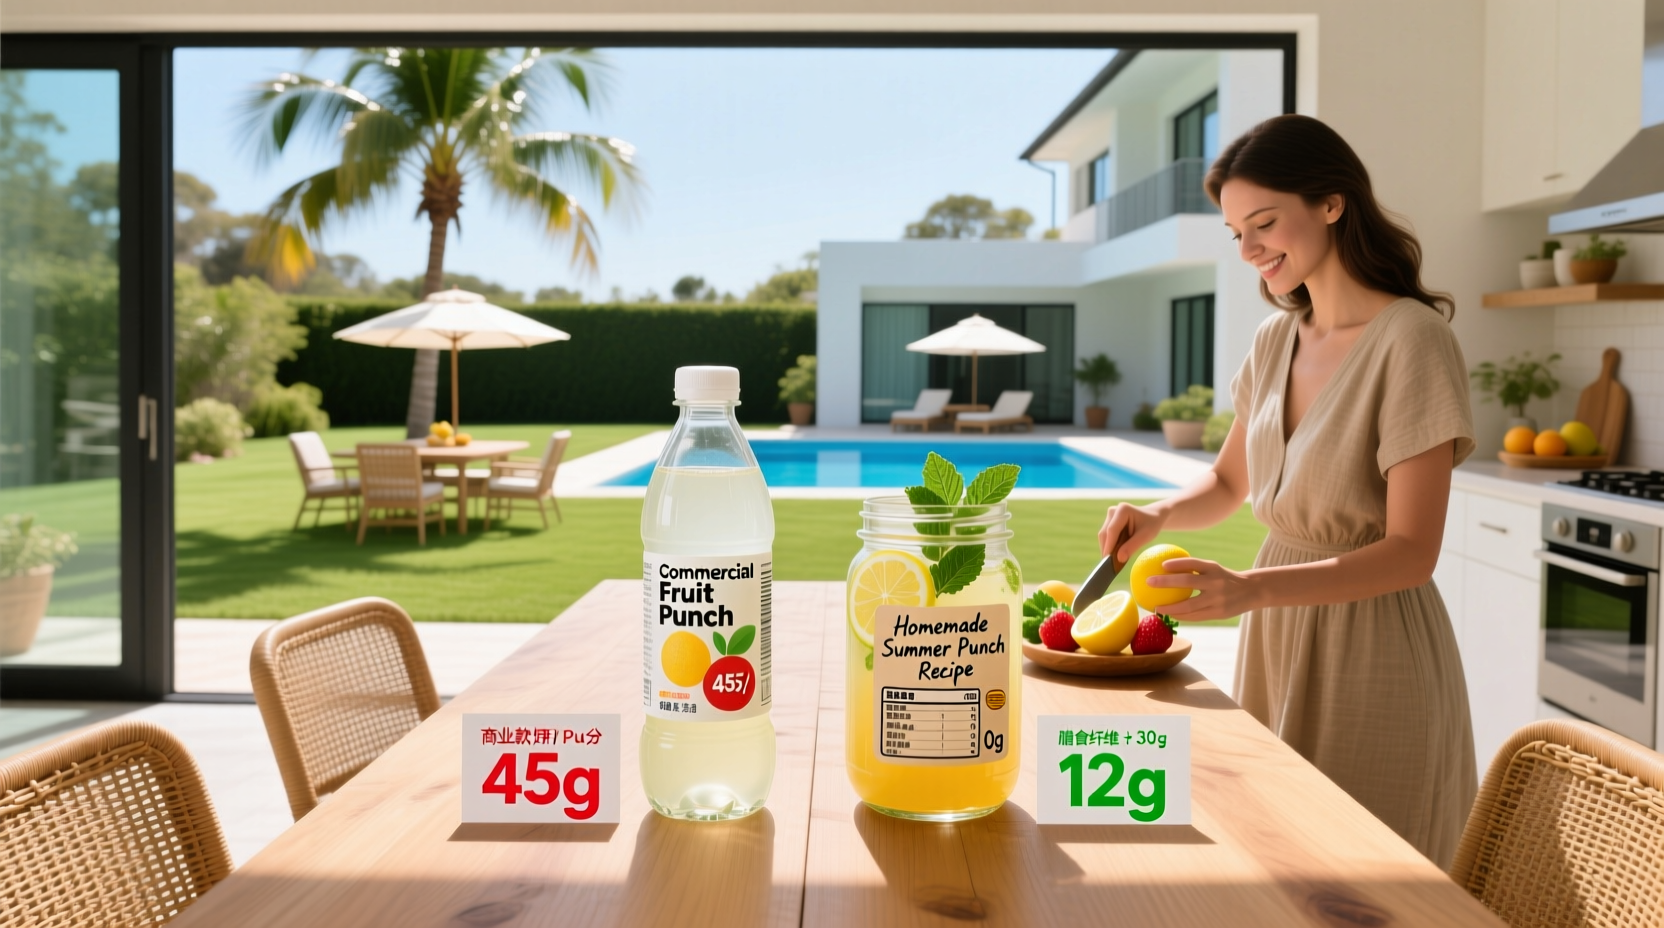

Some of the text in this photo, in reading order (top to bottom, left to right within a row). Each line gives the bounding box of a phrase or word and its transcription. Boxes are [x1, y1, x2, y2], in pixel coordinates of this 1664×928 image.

[659, 562, 754, 580] Commercial
[660, 581, 714, 603] Fruit
[659, 604, 734, 627] Punch
[893, 611, 988, 637] Homemade
[881, 633, 1005, 658] Summer Punch
[918, 660, 974, 687] Recipe
[983, 729, 1004, 754] 0g
[481, 752, 600, 821] 45g
[1058, 752, 1167, 823] 12g
